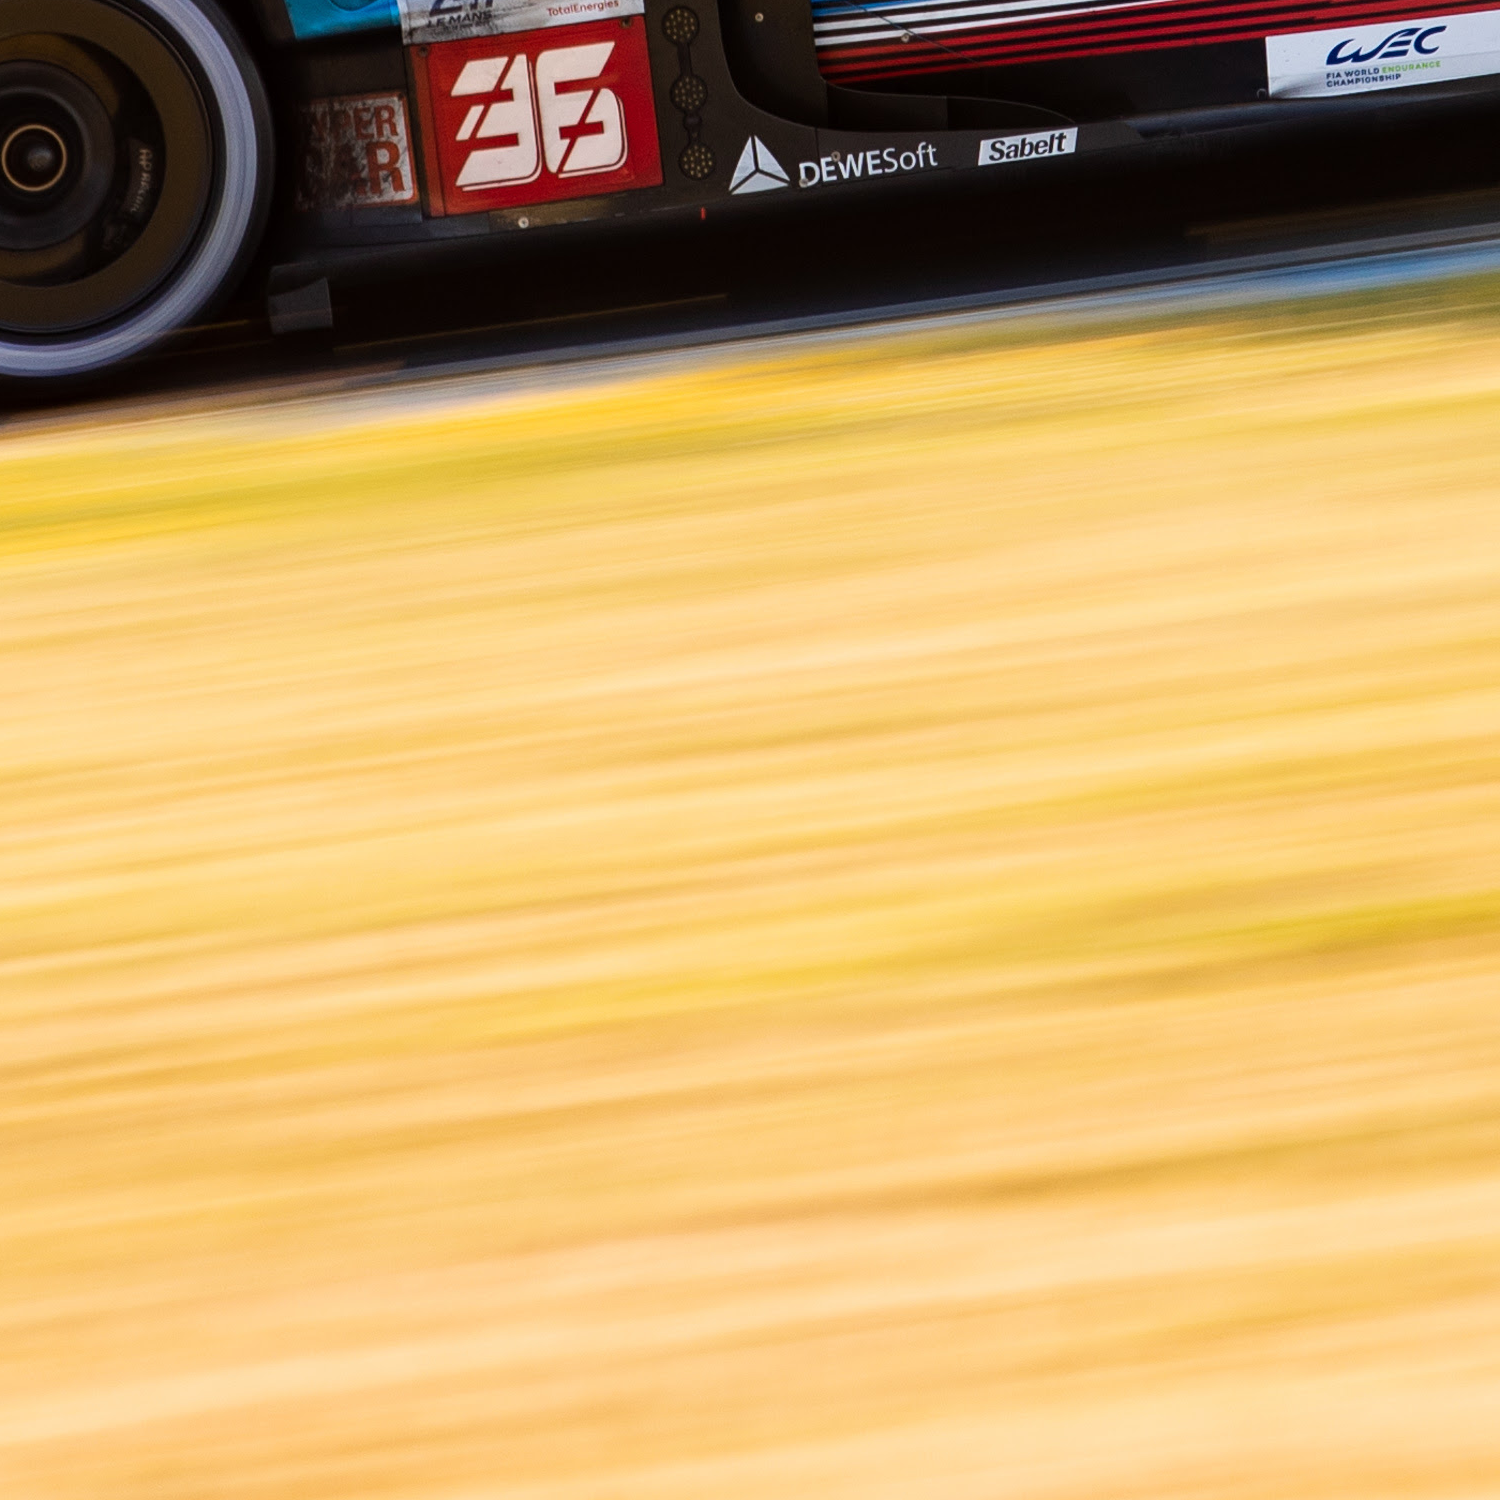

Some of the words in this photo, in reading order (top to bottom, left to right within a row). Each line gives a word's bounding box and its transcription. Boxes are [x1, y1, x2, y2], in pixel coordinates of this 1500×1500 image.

[449, 10, 494, 27] MANS
[546, 0, 620, 18] TotalEnergies
[1326, 25, 1448, 66] WEC
[1326, 72, 1342, 80] FIA
[1344, 67, 1380, 78] WORLD
[1381, 60, 1441, 74] ENDURANCE
[1326, 73, 1402, 88] CHAMPIONSHIP
[450, 41, 628, 192] 36
[988, 132, 1067, 161] Sabelt
[799, 141, 938, 188] DEWESoft
